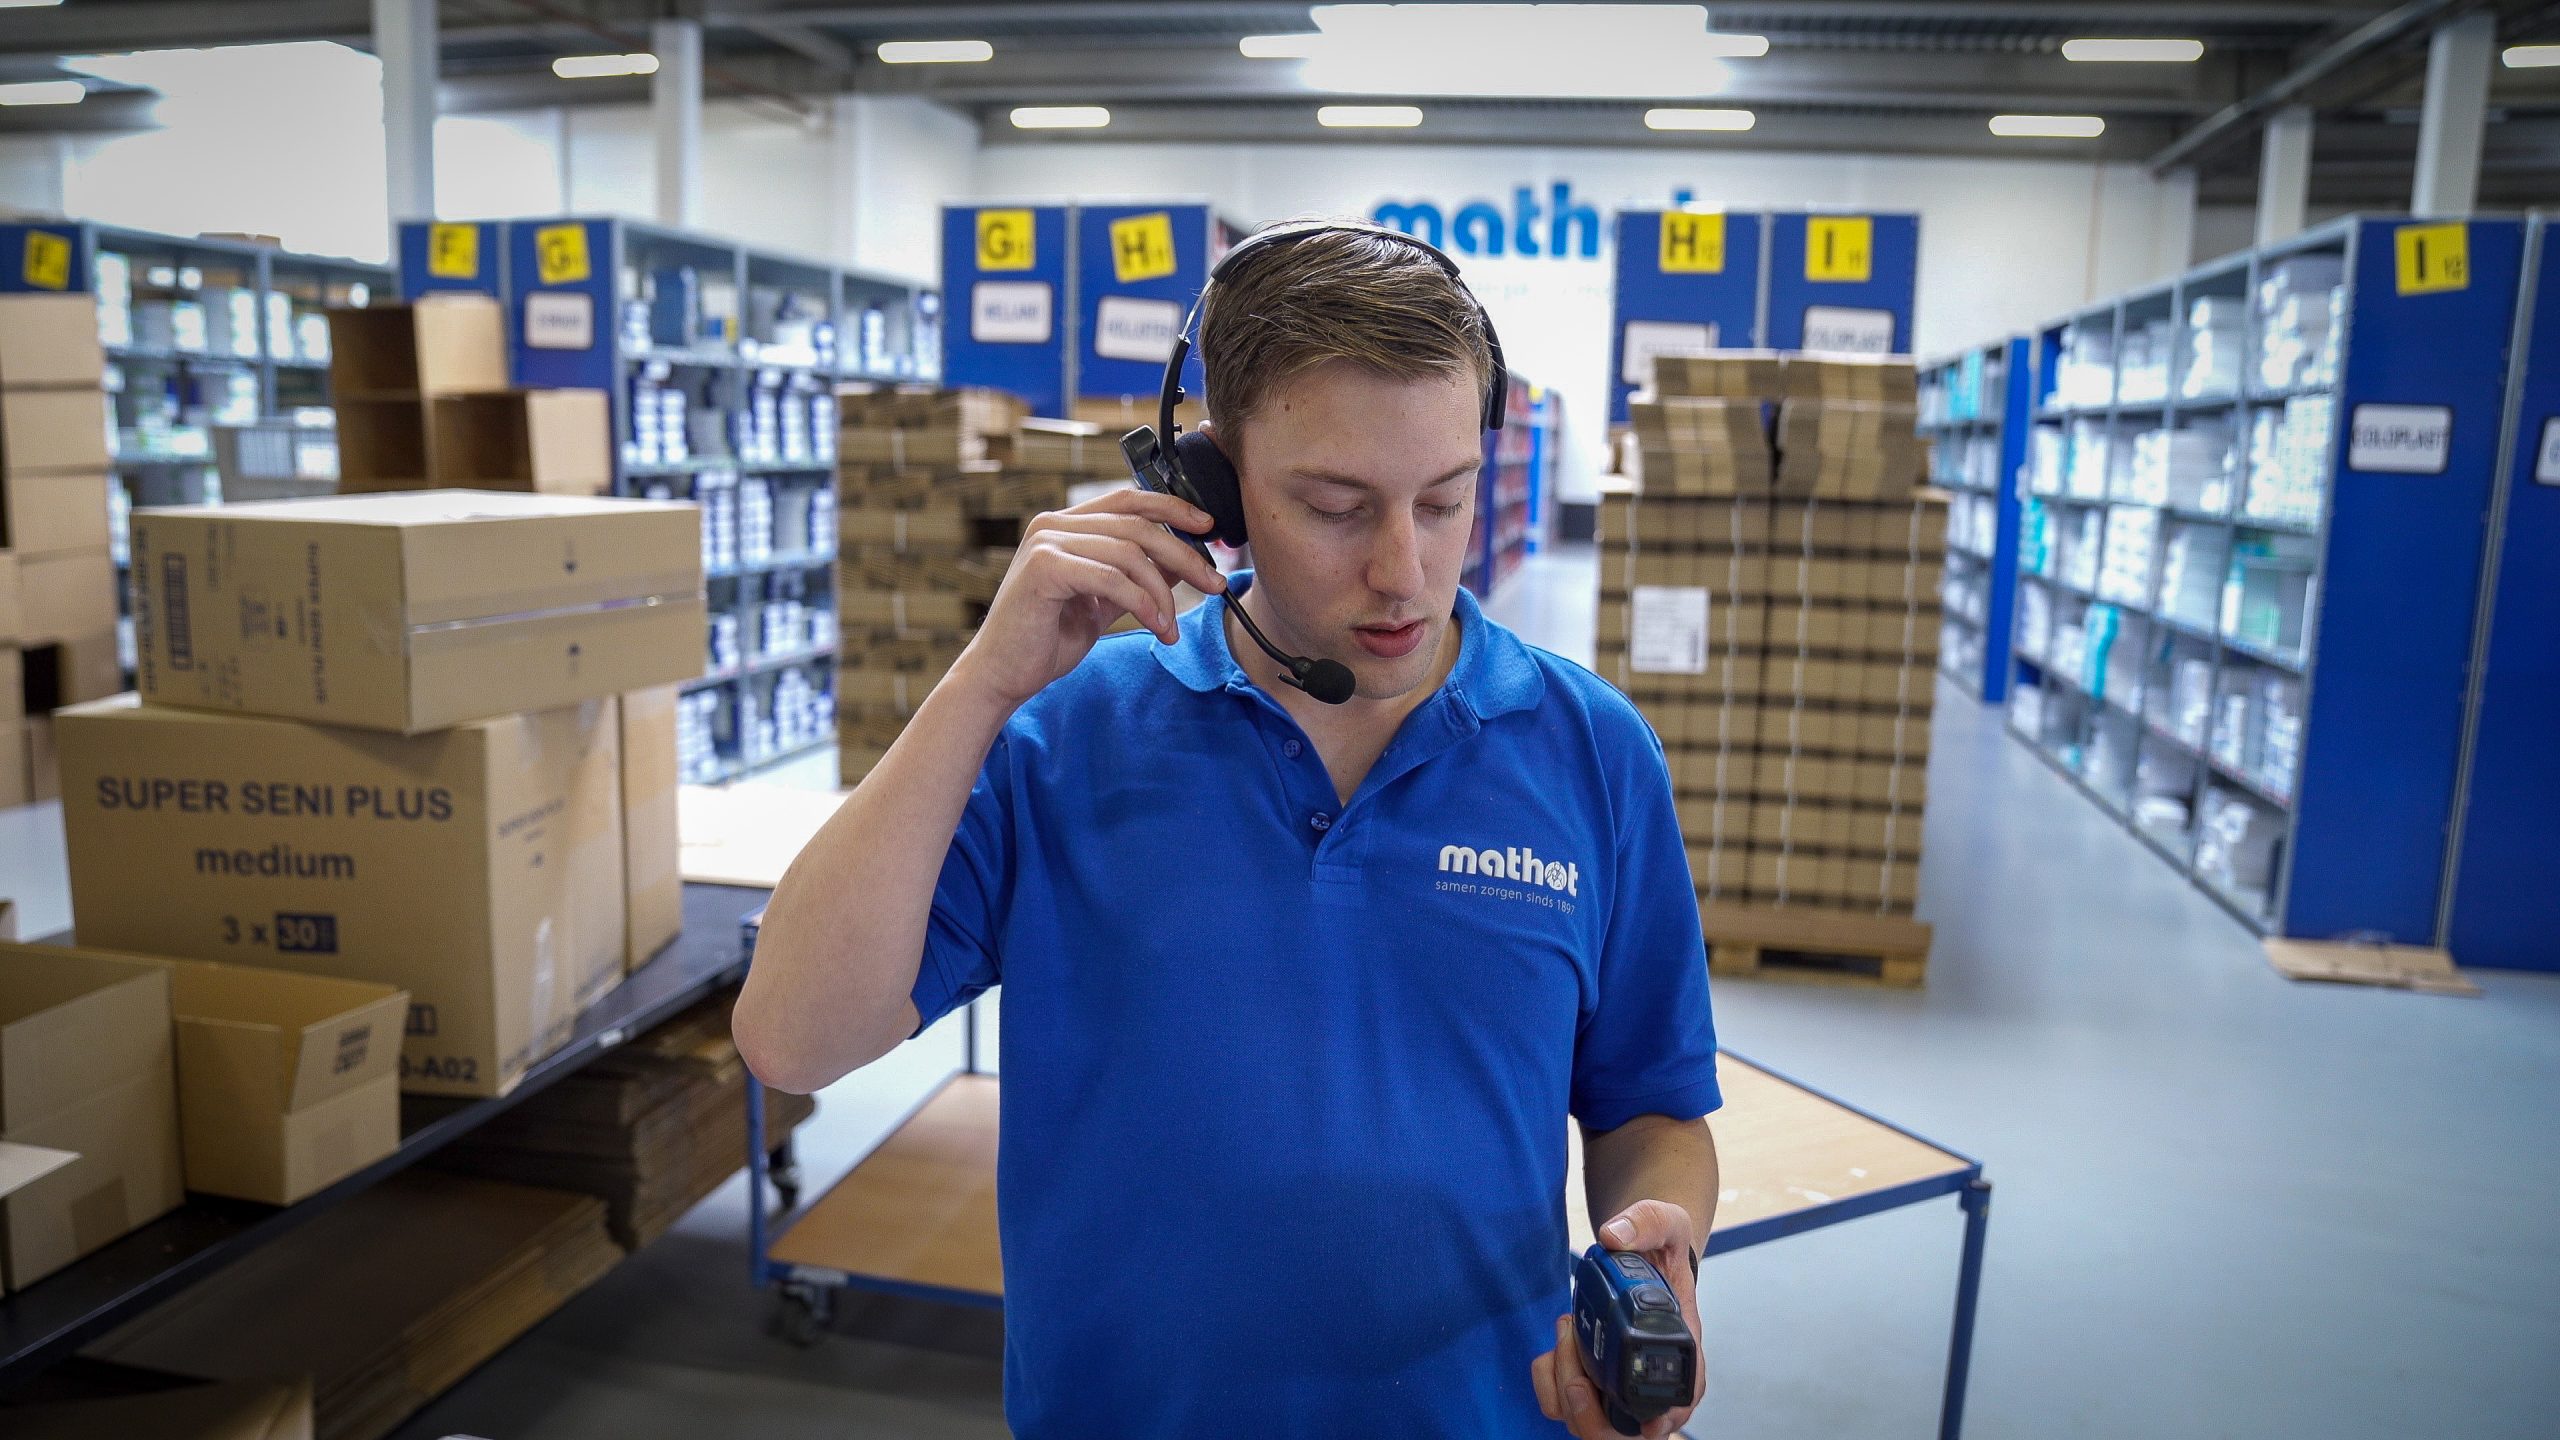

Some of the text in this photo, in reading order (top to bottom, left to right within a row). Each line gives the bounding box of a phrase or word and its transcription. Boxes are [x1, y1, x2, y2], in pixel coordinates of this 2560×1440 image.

[981, 219, 1013, 261] G
[1119, 229, 1151, 271] H
[1668, 219, 1697, 262] H
[1824, 226, 1835, 271] I
[2416, 234, 2427, 281] I
[97, 777, 453, 822] SUPER SENI PLUS
[196, 845, 355, 879] medium
[1438, 844, 1579, 897] mathot
[1435, 880, 1477, 894] samen
[1480, 885, 1523, 902] zorgen
[1526, 892, 1554, 909] sinds
[223, 915, 241, 945] 3
[251, 923, 268, 945] x
[278, 916, 319, 949] 30
